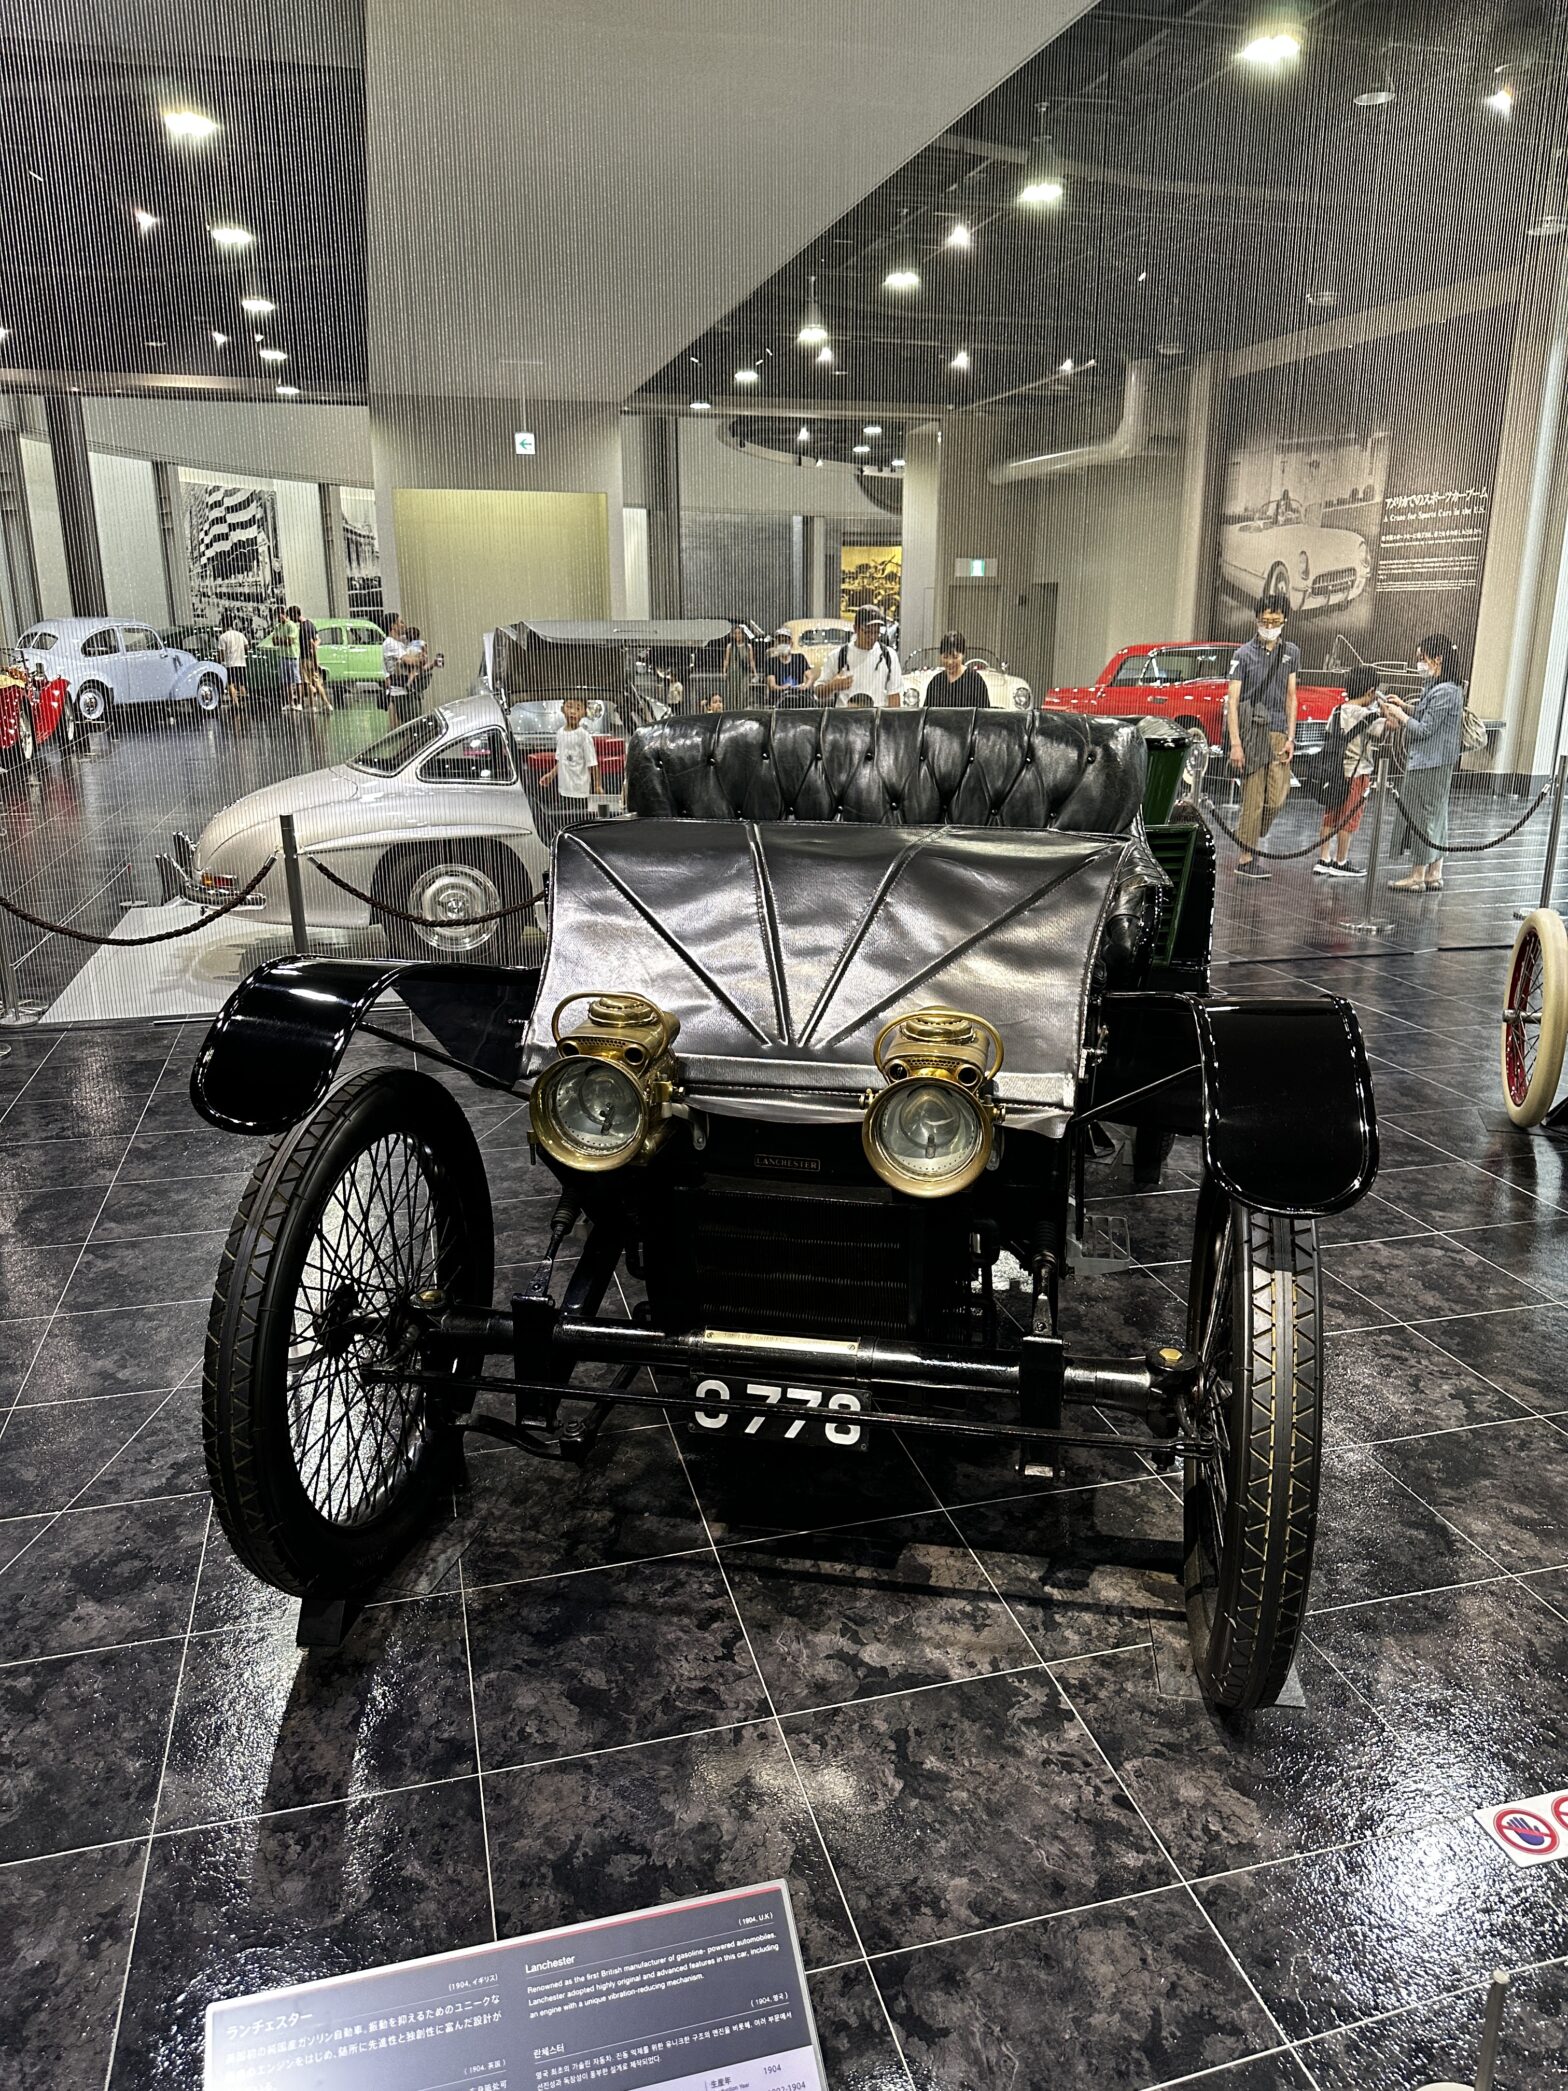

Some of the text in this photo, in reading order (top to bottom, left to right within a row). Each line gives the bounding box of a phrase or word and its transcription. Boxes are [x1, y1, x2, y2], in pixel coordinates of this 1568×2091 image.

[756, 1157, 817, 1169] LANCHESTER
[525, 1955, 576, 1974] Lanchester
[527, 1980, 563, 1994] Renowned
[574, 1975, 585, 1984] the
[586, 1971, 599, 1981] first
[601, 1967, 623, 1977] British
[623, 1957, 667, 1972] manufacturer
[668, 1953, 675, 1962] of
[707, 1941, 736, 1954] powered
[736, 1932, 777, 1947] automobiles.
[528, 1943, 779, 2007] Lanchester adopted highly original and advanced features in this car, including
[529, 2011, 539, 2019] an
[539, 2005, 562, 2017] engine
[563, 2001, 578, 2012] with
[584, 1995, 607, 2007] unique
[607, 1981, 666, 2002] vibration-reducing
[666, 1972, 705, 1988] mechanism.
[226, 2012, 313, 2041] ランチェスター
[763, 2064, 782, 2075] 1904
